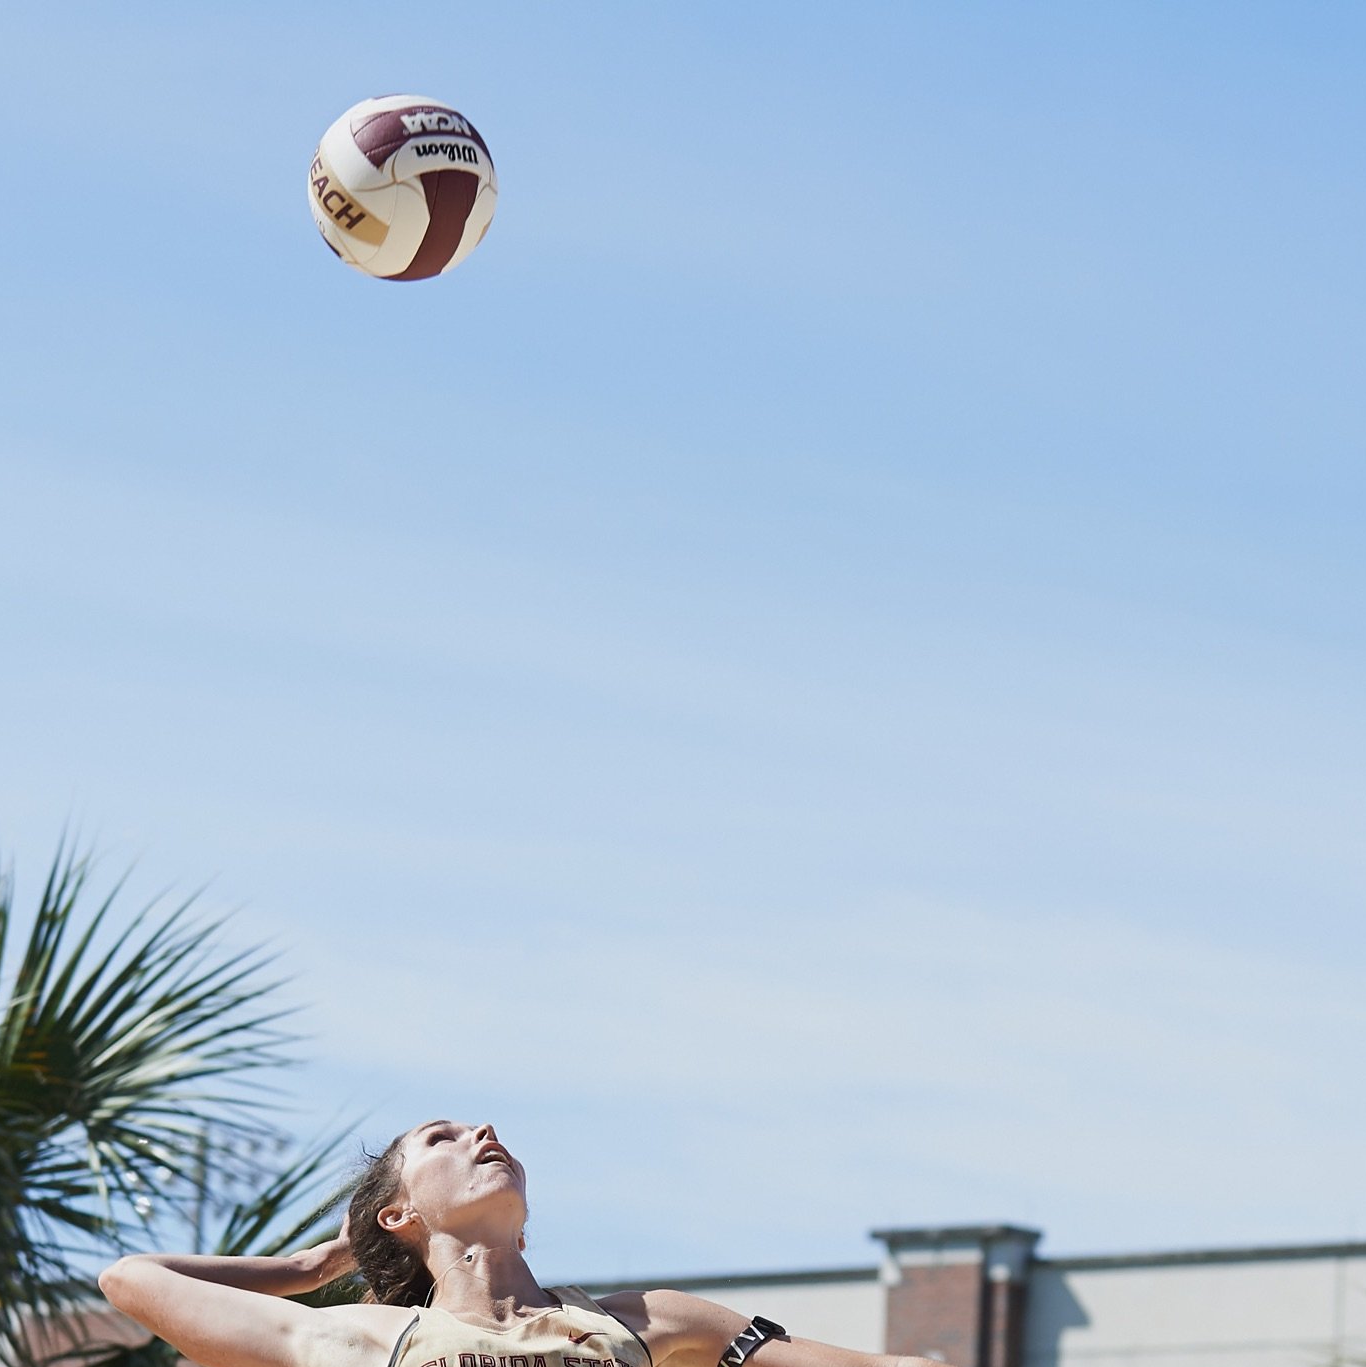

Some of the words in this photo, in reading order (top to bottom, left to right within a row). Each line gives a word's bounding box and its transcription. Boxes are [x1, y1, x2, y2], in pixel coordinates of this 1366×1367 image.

[400, 112, 472, 137] NCAA
[414, 143, 479, 165] Wilson
[311, 146, 366, 230] EACH
